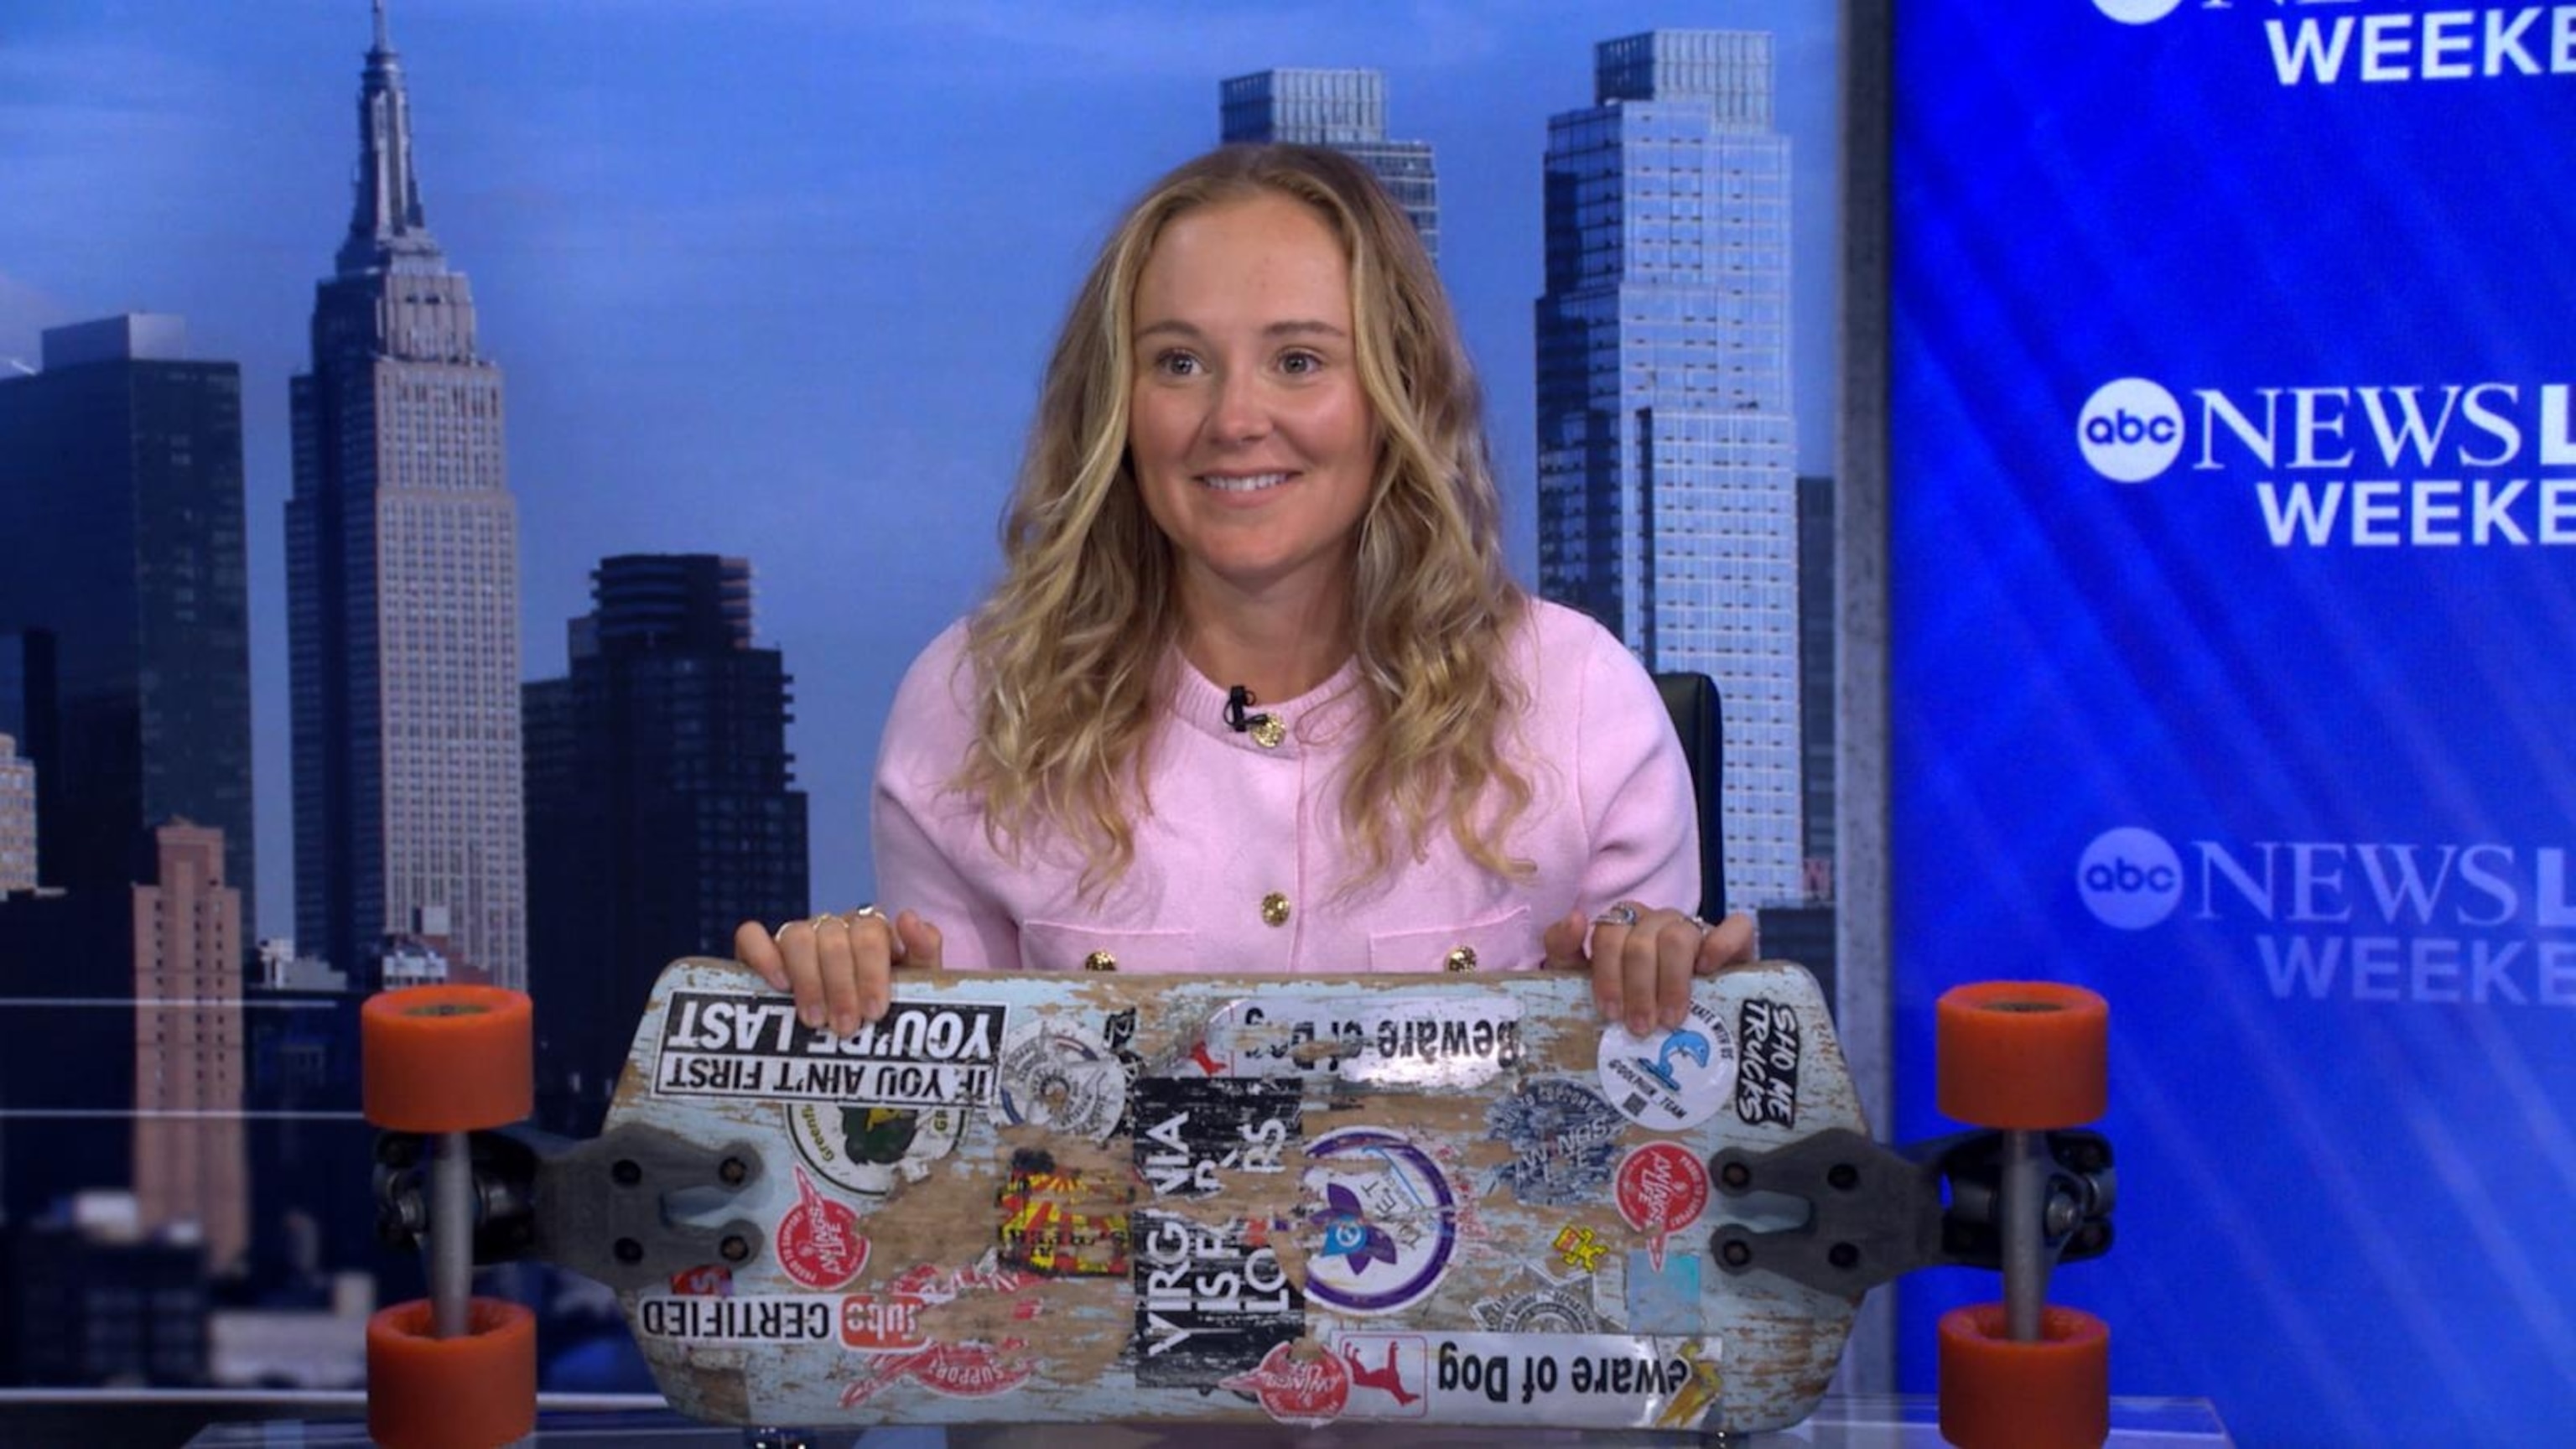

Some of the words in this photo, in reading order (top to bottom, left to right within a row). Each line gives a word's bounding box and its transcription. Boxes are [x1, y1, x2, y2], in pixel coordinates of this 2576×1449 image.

[2086, 408, 2175, 445] abc
[2193, 383, 2520, 470] NEWS
[2085, 858, 2175, 894] abc
[2191, 839, 2517, 925] NEWS
[667, 1000, 796, 1052] LAST
[1375, 1020, 1519, 1070] Beware
[1771, 1008, 1797, 1071] SHO
[666, 1057, 764, 1089] FIRST
[773, 1062, 865, 1093] AIN'T
[875, 1067, 944, 1098] YOU
[954, 1069, 988, 1099] IF
[1739, 1003, 1769, 1122] TRUCKS
[1767, 1078, 1793, 1121] ME
[1244, 1118, 1289, 1312] LORS
[1197, 1272, 1240, 1311] IS
[643, 1301, 830, 1339] CERTIFIED
[1438, 1341, 1509, 1403] Dog
[1521, 1357, 1558, 1405] of
[1571, 1357, 1688, 1397] eware
